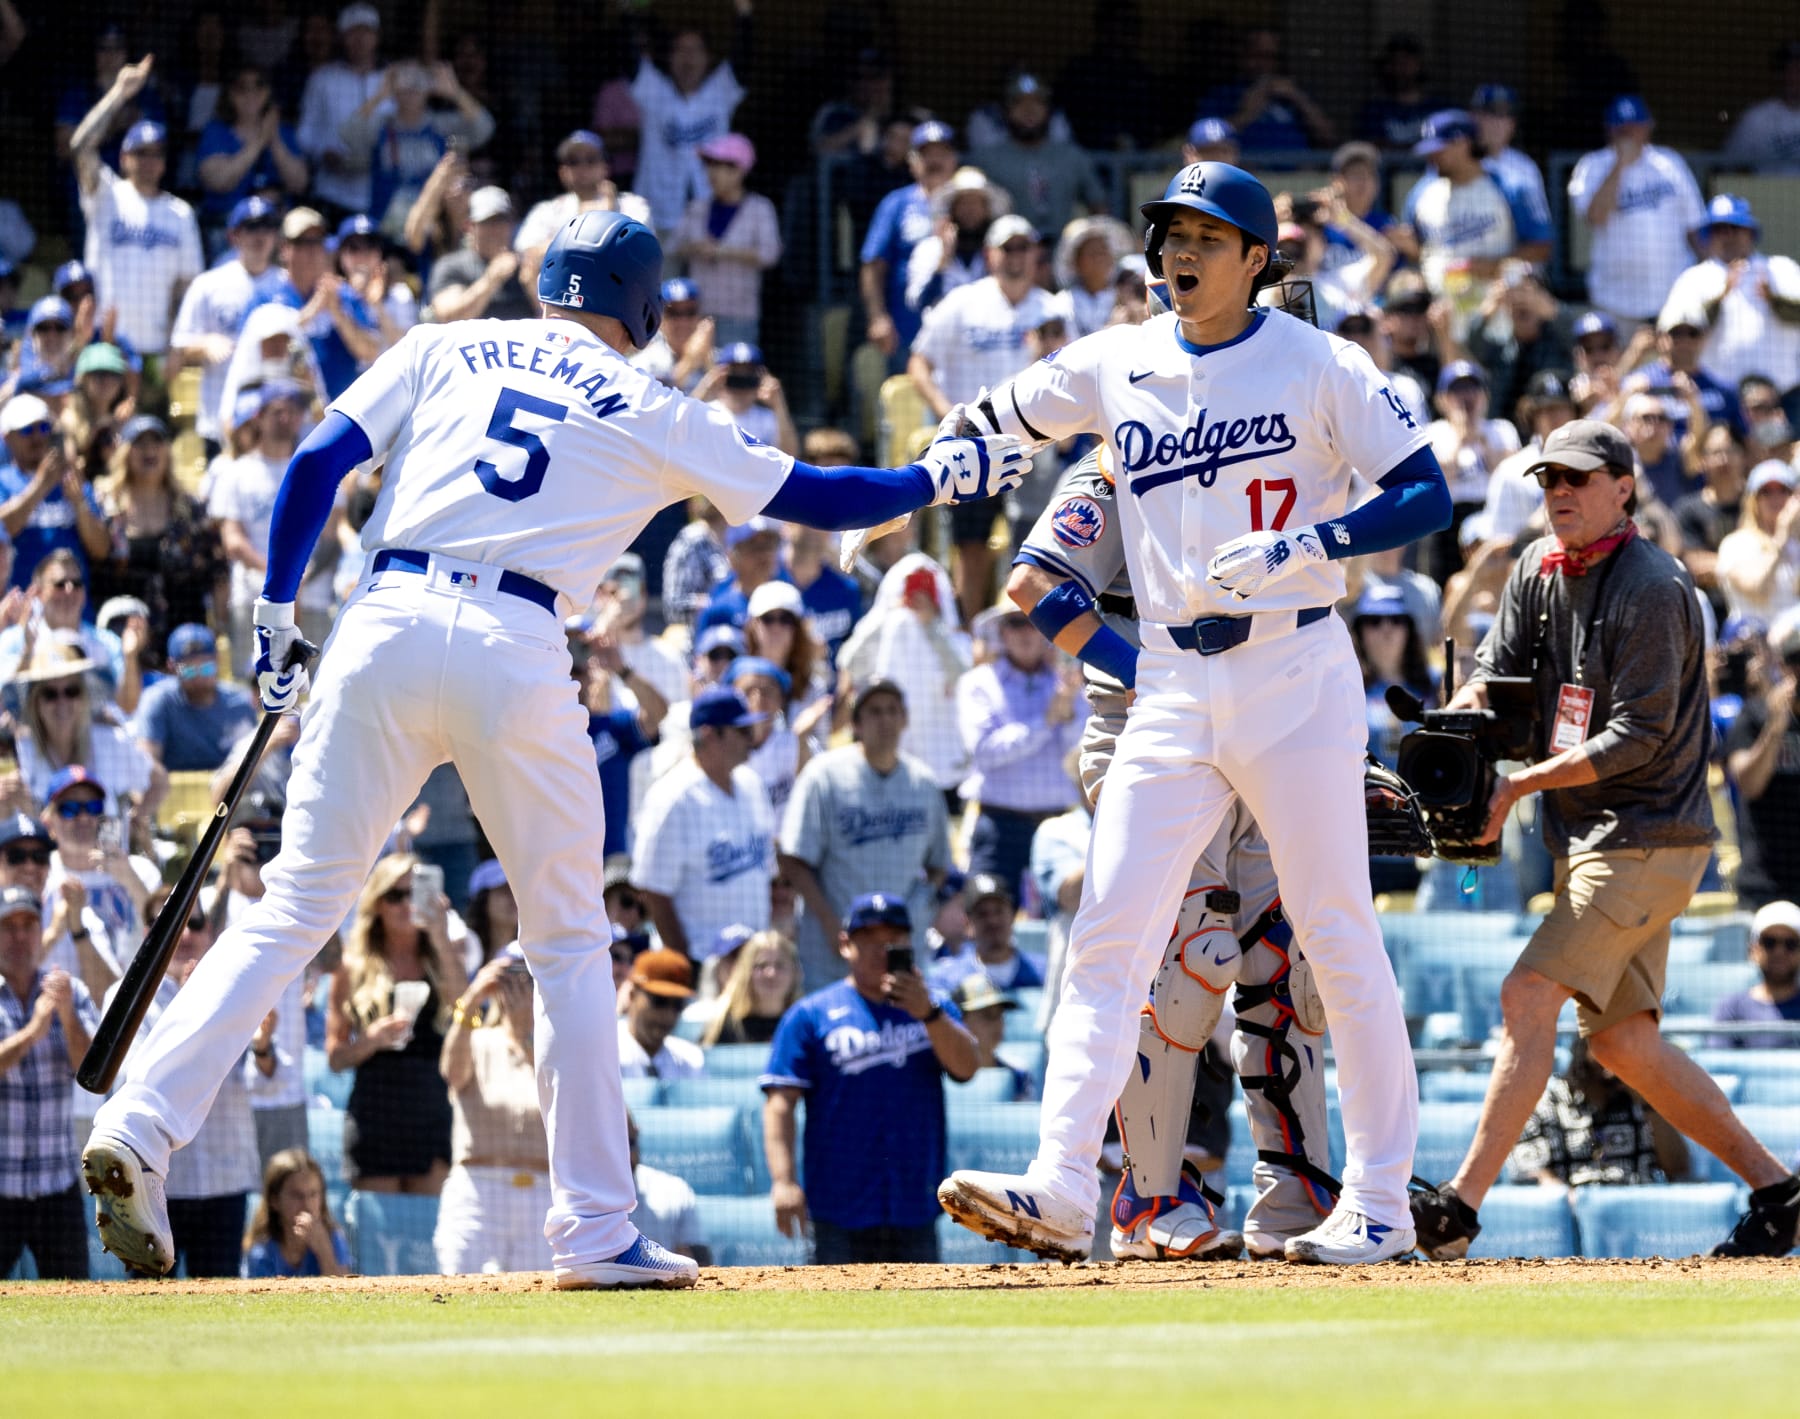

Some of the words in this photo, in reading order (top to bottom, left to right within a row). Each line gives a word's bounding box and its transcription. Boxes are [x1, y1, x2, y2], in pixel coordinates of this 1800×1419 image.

[1180, 163, 1204, 193] LA
[568, 273, 582, 294] 5
[459, 340, 629, 418] FREEMAN
[473, 386, 569, 503] 5
[1114, 408, 1297, 498] Dodgers
[1057, 511, 1096, 538] Mets
[1245, 477, 1298, 533] 17
[825, 1019, 931, 1075] Dodger
[1005, 1189, 1042, 1220] N
